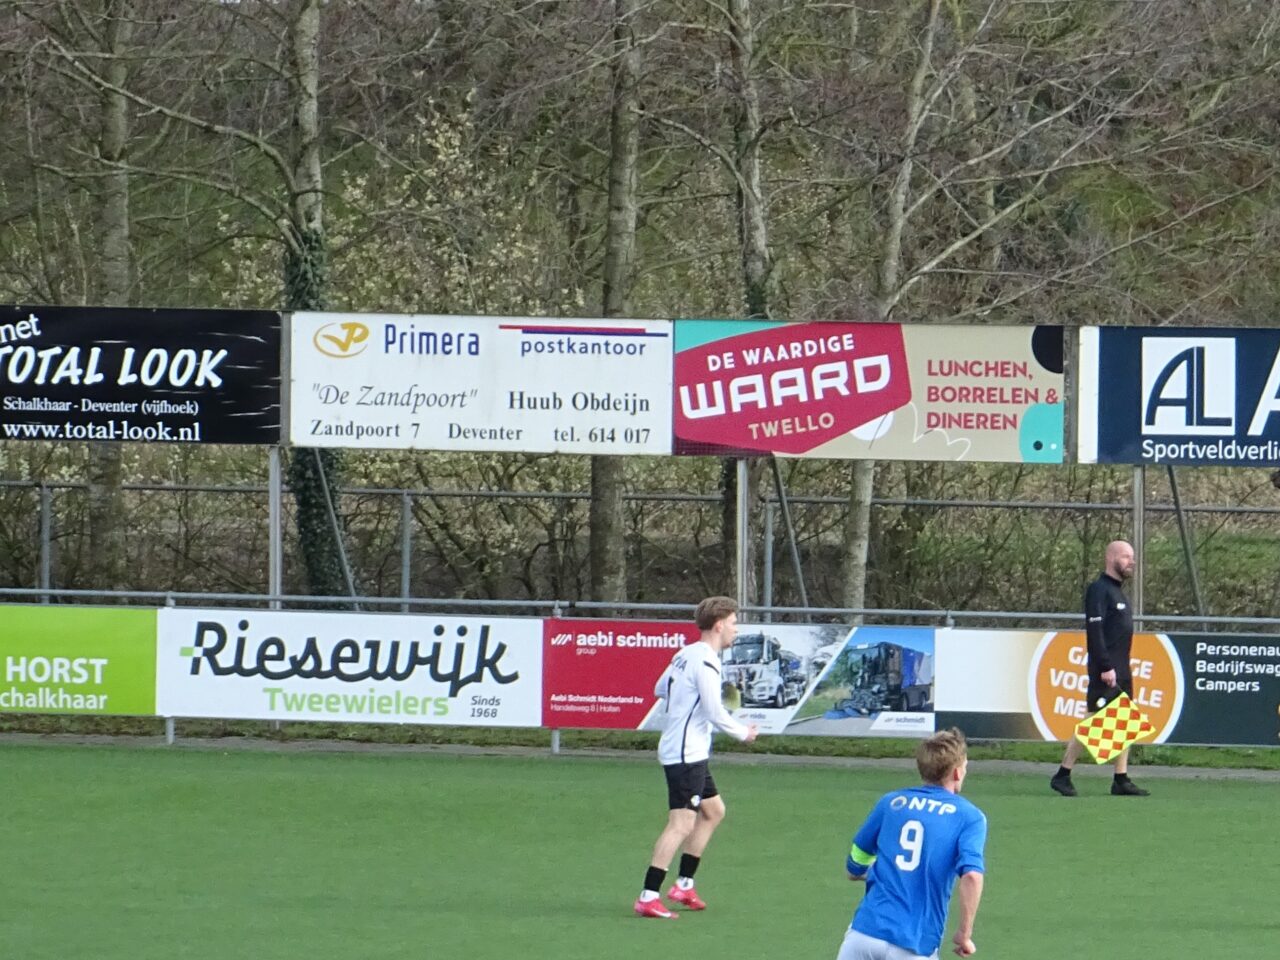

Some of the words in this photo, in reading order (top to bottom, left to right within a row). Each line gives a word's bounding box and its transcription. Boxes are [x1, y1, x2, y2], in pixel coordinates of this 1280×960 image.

[384, 323, 480, 357] Primera
[520, 337, 646, 358] postkantoor
[706, 351, 735, 373] DE
[743, 332, 856, 367] WAARDIGE
[117, 347, 228, 388] LOOK
[926, 359, 1034, 381] LUNCHEN,
[679, 353, 892, 421] WAARD
[926, 385, 1040, 405] BORRELEN
[1044, 387, 1059, 404] &
[3, 397, 72, 412] Schalkhaar
[80, 398, 138, 414] Deventer
[508, 390, 564, 411] Huub
[571, 391, 651, 416] Obdeijn
[2, 421, 201, 441] www.total-look.nl
[310, 419, 401, 442] Zandpoort
[411, 423, 420, 440] 7
[448, 422, 524, 442] Deventer
[748, 411, 836, 441] TWELLO
[926, 411, 1018, 431] DINEREN
[553, 425, 581, 443] tel.
[588, 427, 617, 444] 614
[624, 427, 651, 444] 017
[576, 631, 614, 647] aebi
[616, 632, 687, 649] schmidt
[189, 619, 520, 698] Riesewijk
[5, 656, 109, 686] HORST
[1049, 667, 1090, 694] VOO
[1195, 678, 1260, 693] Campers
[263, 686, 449, 716] Tweewielers
[470, 694, 501, 707] Sinds
[470, 707, 498, 719] 1968
[908, 796, 957, 816] NTP
[895, 819, 925, 872] 9
